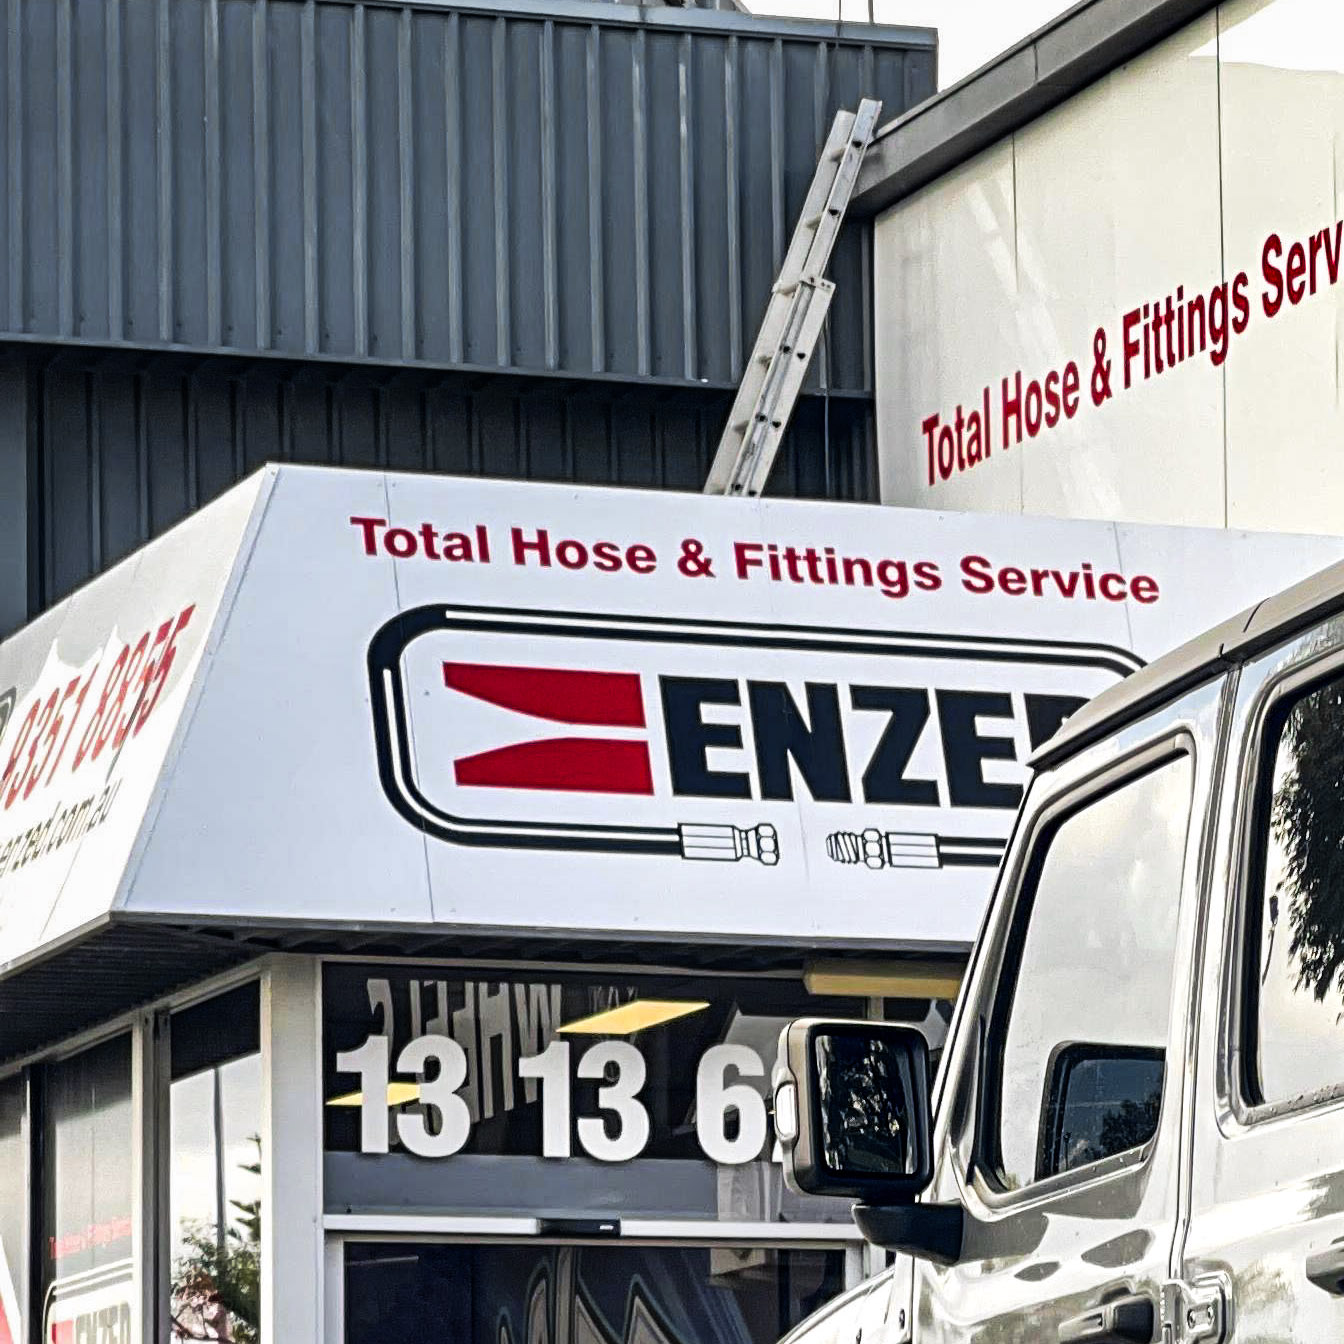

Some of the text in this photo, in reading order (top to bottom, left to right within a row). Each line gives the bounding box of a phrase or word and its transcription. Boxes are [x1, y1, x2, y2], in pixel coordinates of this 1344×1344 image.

[922, 387, 992, 485] Total
[1002, 362, 1081, 449] Hose
[1091, 327, 1113, 405] &
[1123, 273, 1250, 389] Fittings
[350, 517, 1159, 604] Total Hose & Fittings Service
[72, 603, 196, 773] 8855
[336, 1034, 790, 1166] 13 13 6
